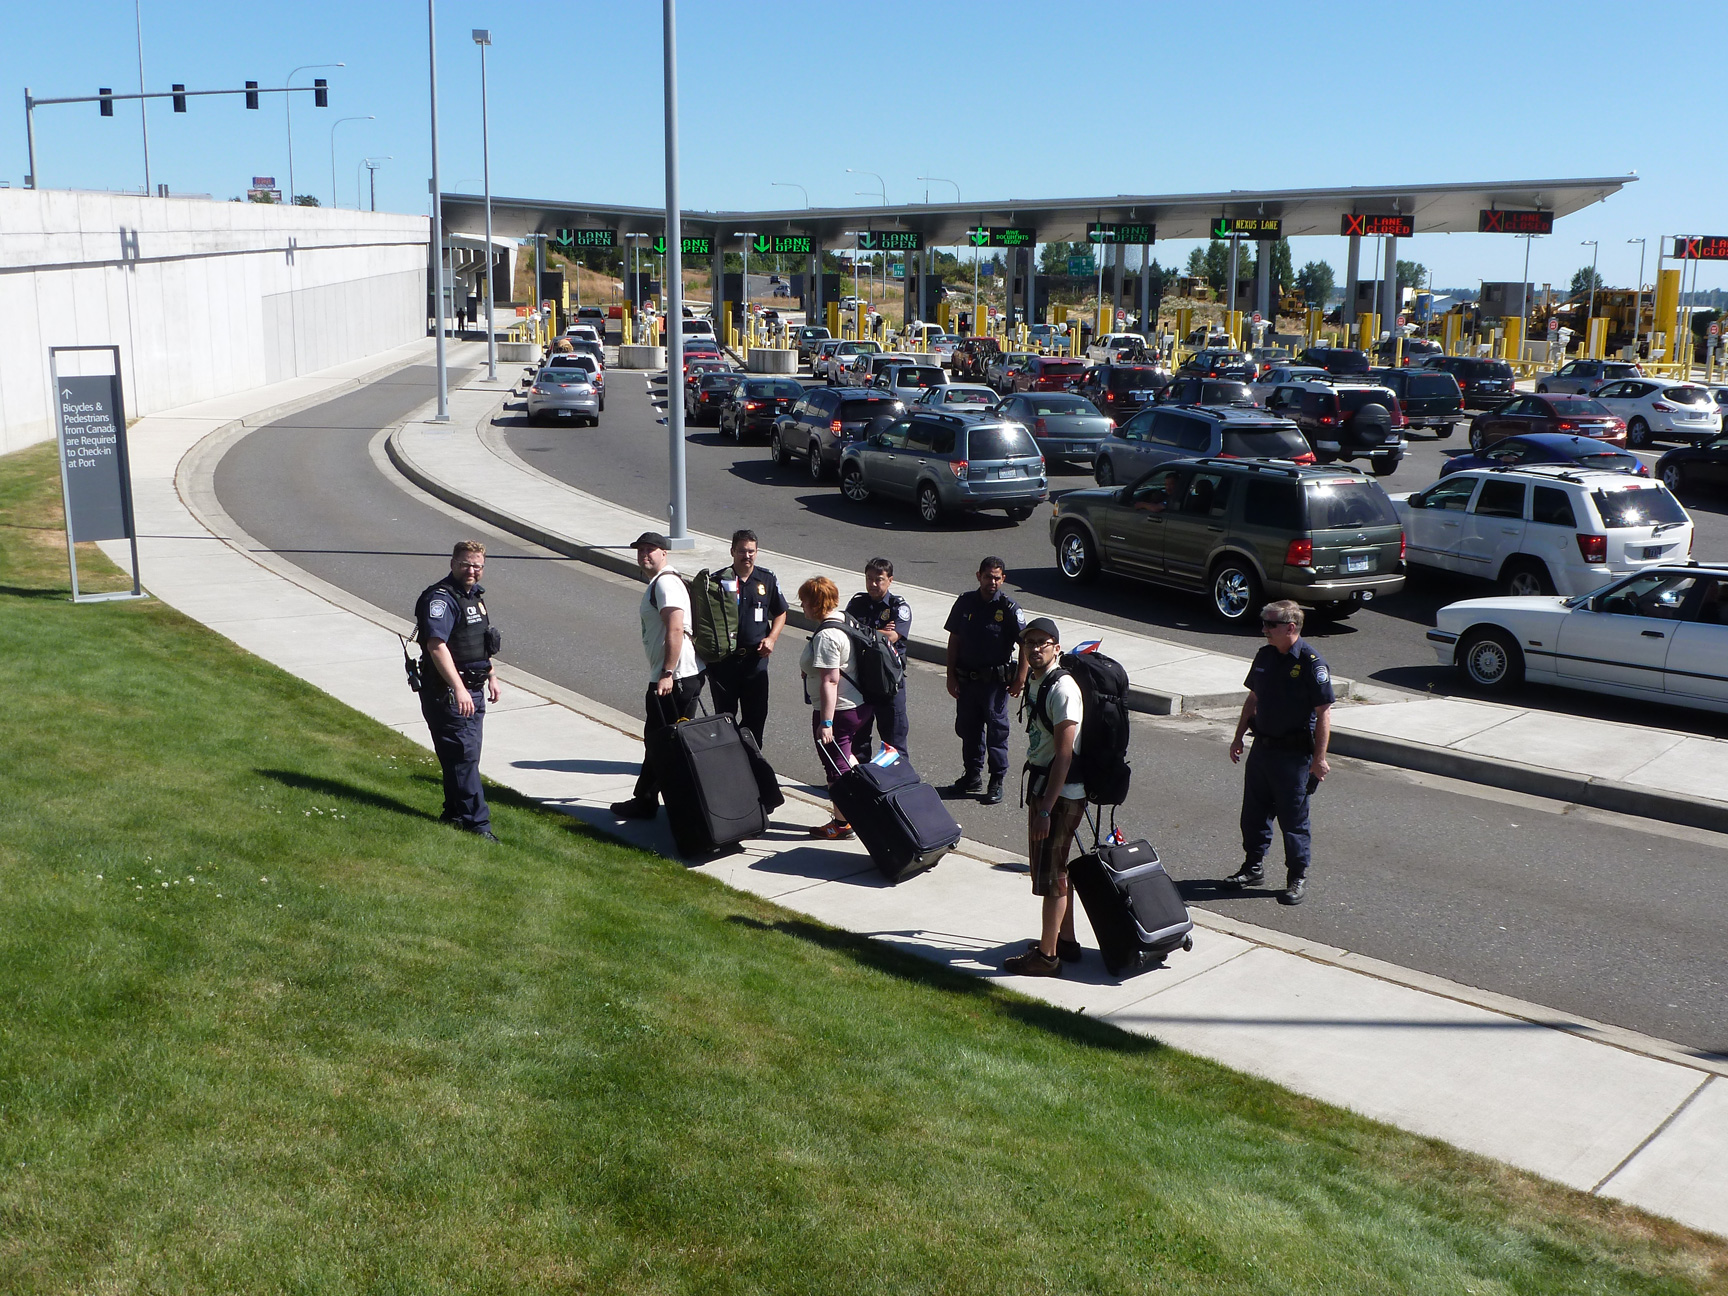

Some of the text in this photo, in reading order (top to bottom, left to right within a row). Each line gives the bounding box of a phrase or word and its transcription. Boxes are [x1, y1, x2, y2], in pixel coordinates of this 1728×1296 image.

[1374, 217, 1404, 226] LANE
[1513, 213, 1542, 222] LANE
[1236, 219, 1278, 230] NEXUS LANE
[1505, 221, 1549, 230] CLOSED
[1112, 226, 1149, 234] LANE
[1366, 225, 1410, 234] CLOSED
[577, 231, 612, 239] LANE
[881, 233, 918, 241] LANE
[1112, 233, 1148, 242] OPEN
[577, 238, 611, 246] OPEN
[681, 239, 709, 247] ANE
[775, 238, 811, 246] LANE
[881, 240, 917, 248] OPEN
[1711, 239, 1728, 248] LA
[775, 244, 810, 253] OPEN
[1703, 247, 1728, 257] CLO
[63, 402, 103, 414] Bicycles &
[64, 413, 109, 424] Pedestrians
[65, 423, 117, 435] from Canada
[66, 434, 117, 446] are Required
[67, 446, 111, 457] to Check-in
[68, 458, 96, 468] at Port
